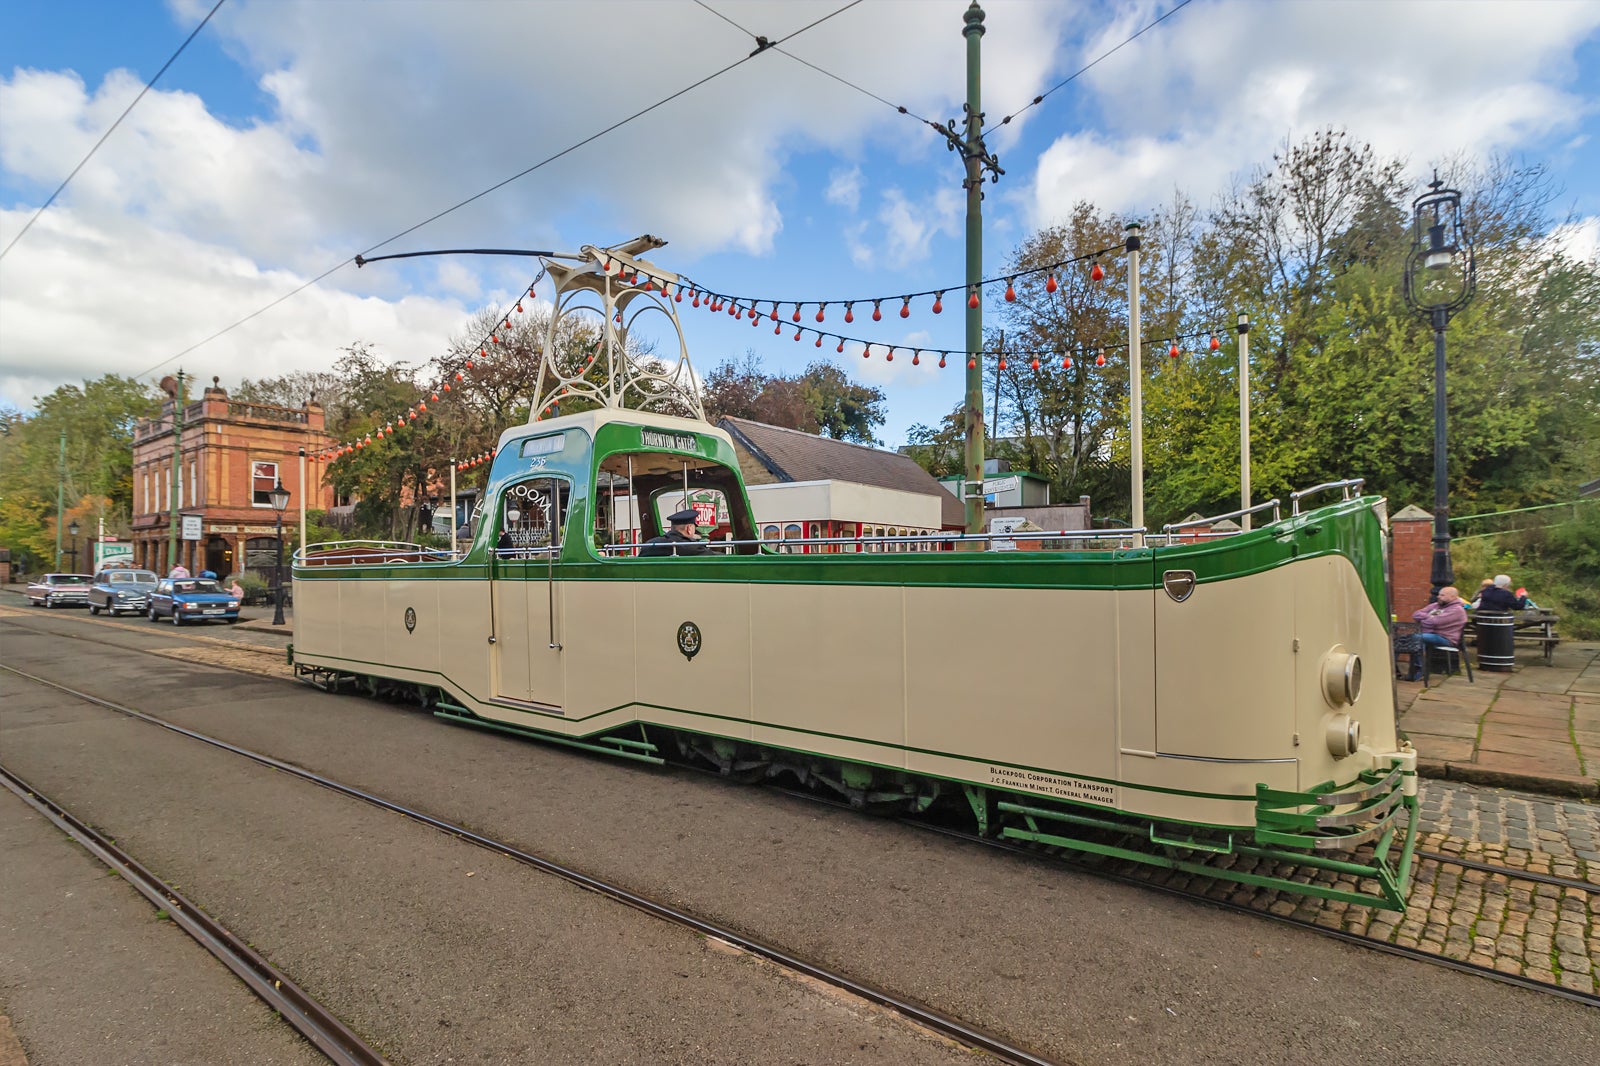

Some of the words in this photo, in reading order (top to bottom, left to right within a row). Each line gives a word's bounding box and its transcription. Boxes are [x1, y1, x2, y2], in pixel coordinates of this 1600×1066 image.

[641, 431, 675, 449] THORNTON
[676, 436, 694, 451] GATE
[529, 456, 547, 468] 236
[695, 507, 713, 522] STOP
